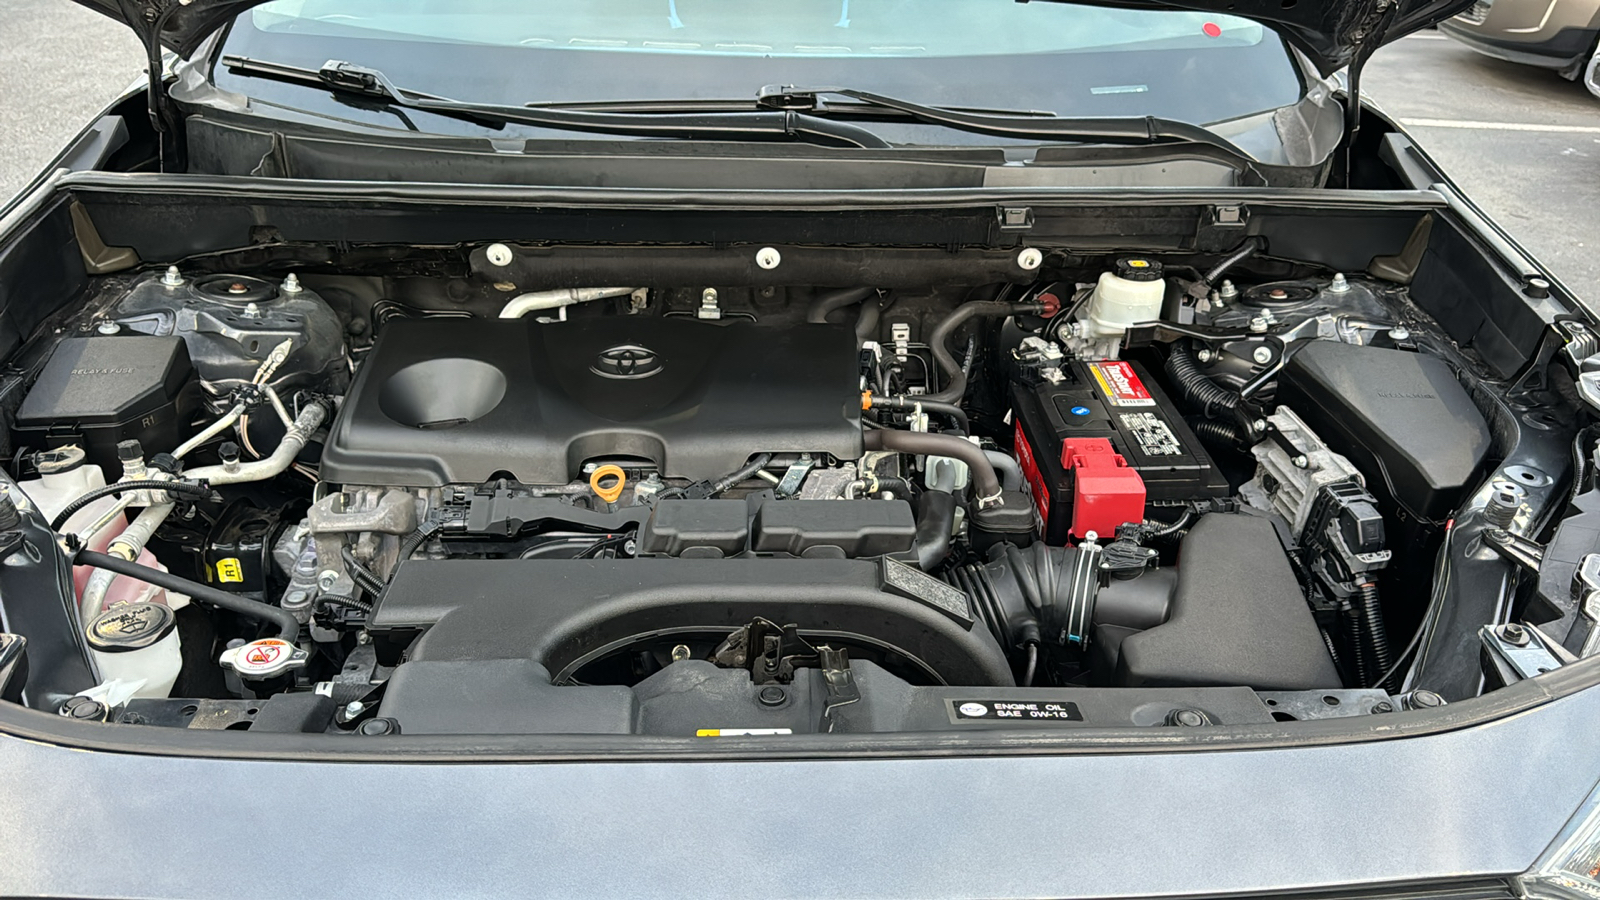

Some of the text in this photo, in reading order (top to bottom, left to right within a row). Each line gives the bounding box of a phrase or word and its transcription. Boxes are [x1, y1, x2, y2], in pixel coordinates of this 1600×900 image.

[142, 415, 154, 428] R1
[224, 564, 235, 577] R1
[994, 703, 1038, 711] ENGINE
